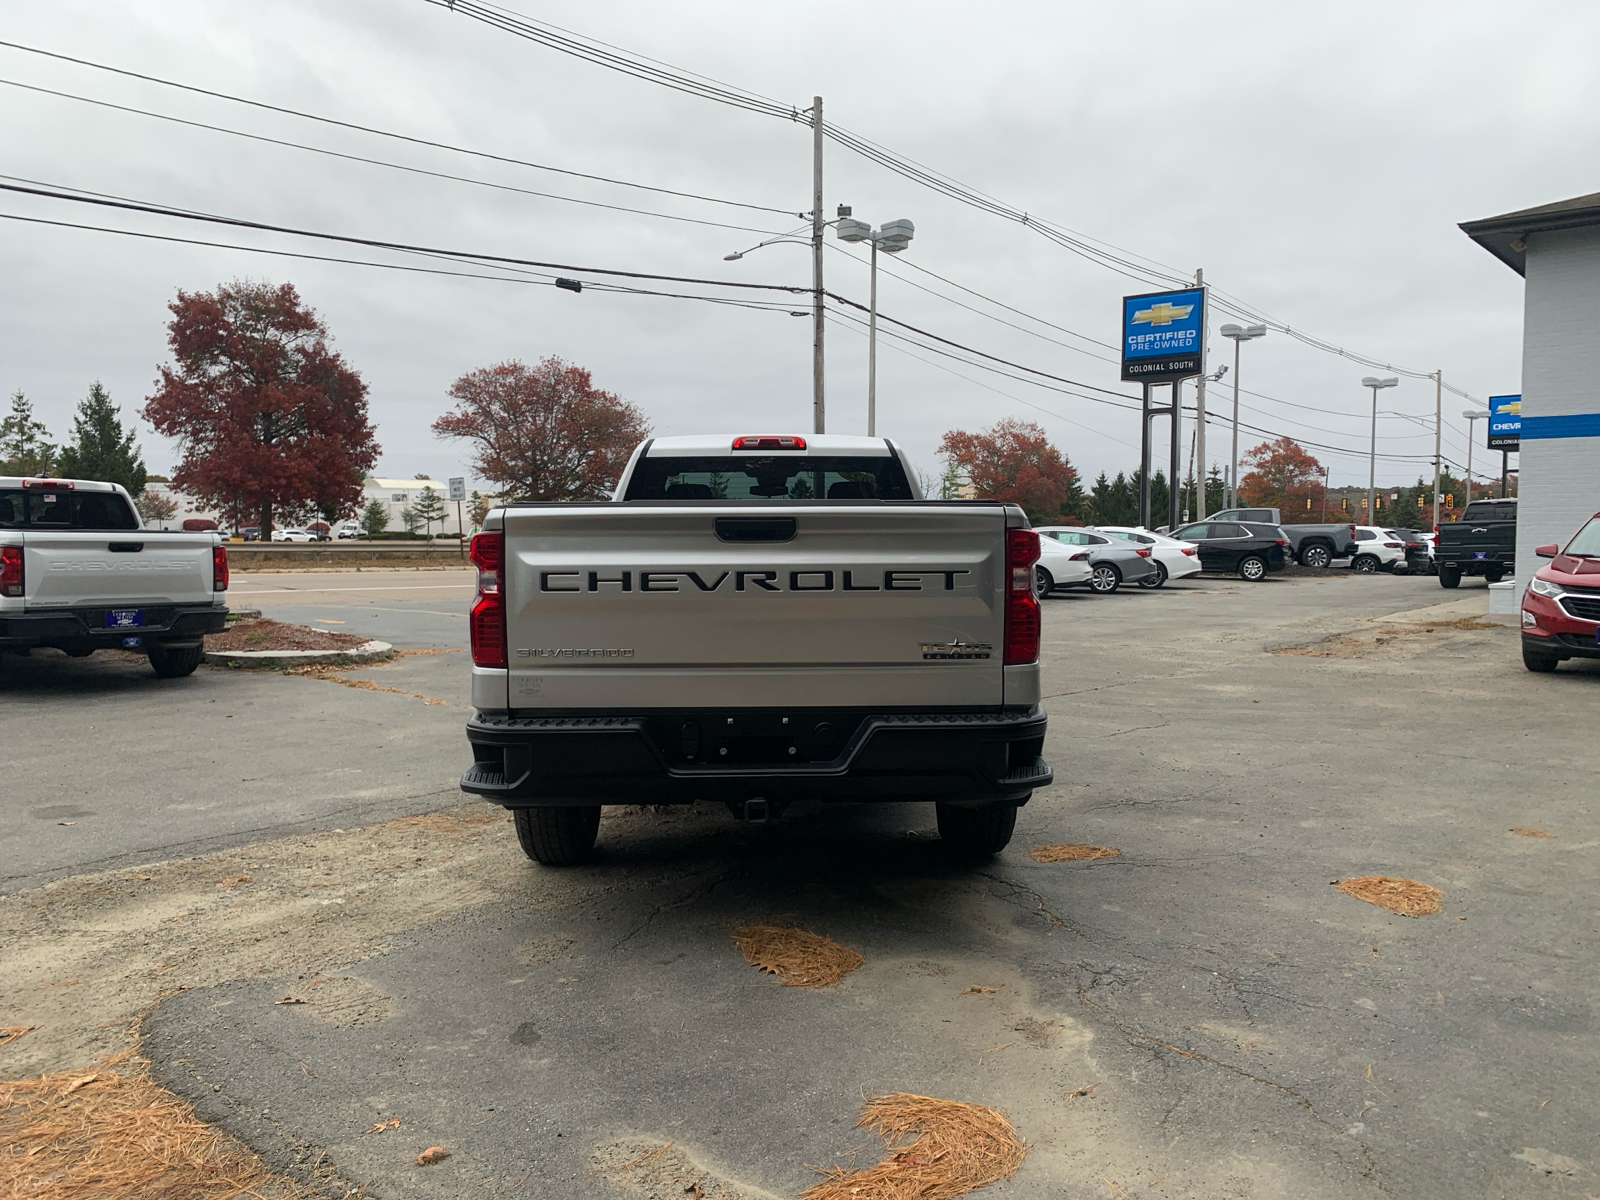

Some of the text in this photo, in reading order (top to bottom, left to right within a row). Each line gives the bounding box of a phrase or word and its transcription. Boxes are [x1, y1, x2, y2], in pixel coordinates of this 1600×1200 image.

[1128, 329, 1196, 344] CERTIFIED
[1131, 338, 1193, 352] PRE-OWNED
[1129, 361, 1194, 373] COLONIAL SOUTH
[48, 560, 197, 571] CHEVROLET
[540, 570, 971, 592] CHEVROLET
[517, 648, 634, 657] SILVERADO
